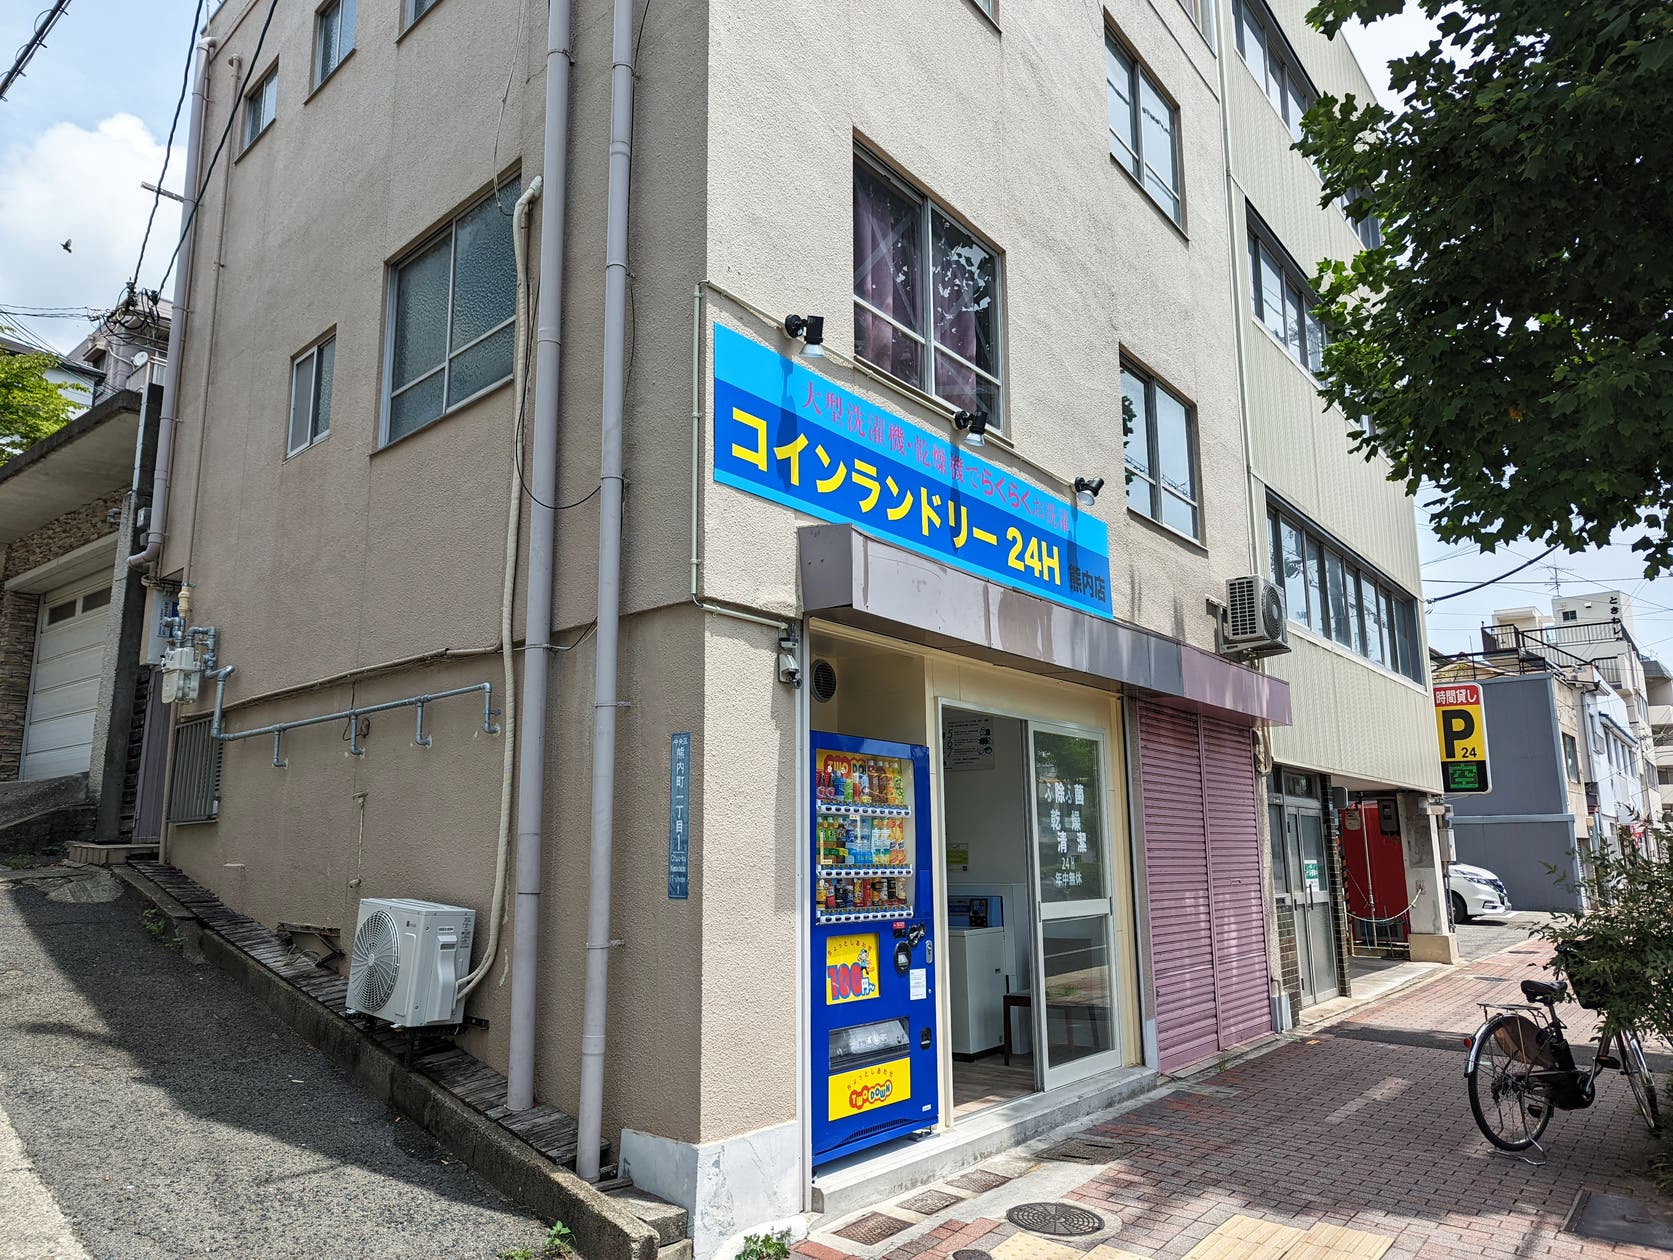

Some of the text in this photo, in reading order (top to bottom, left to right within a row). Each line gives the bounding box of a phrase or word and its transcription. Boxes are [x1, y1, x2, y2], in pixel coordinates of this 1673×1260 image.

[731, 407, 1061, 586] コインランドリー 24H
[1069, 564, 1106, 603] 熊内店
[1435, 689, 1477, 705] 時間貸し
[1442, 709, 1477, 759] P 24
[1055, 872, 1083, 889] 年中無休
